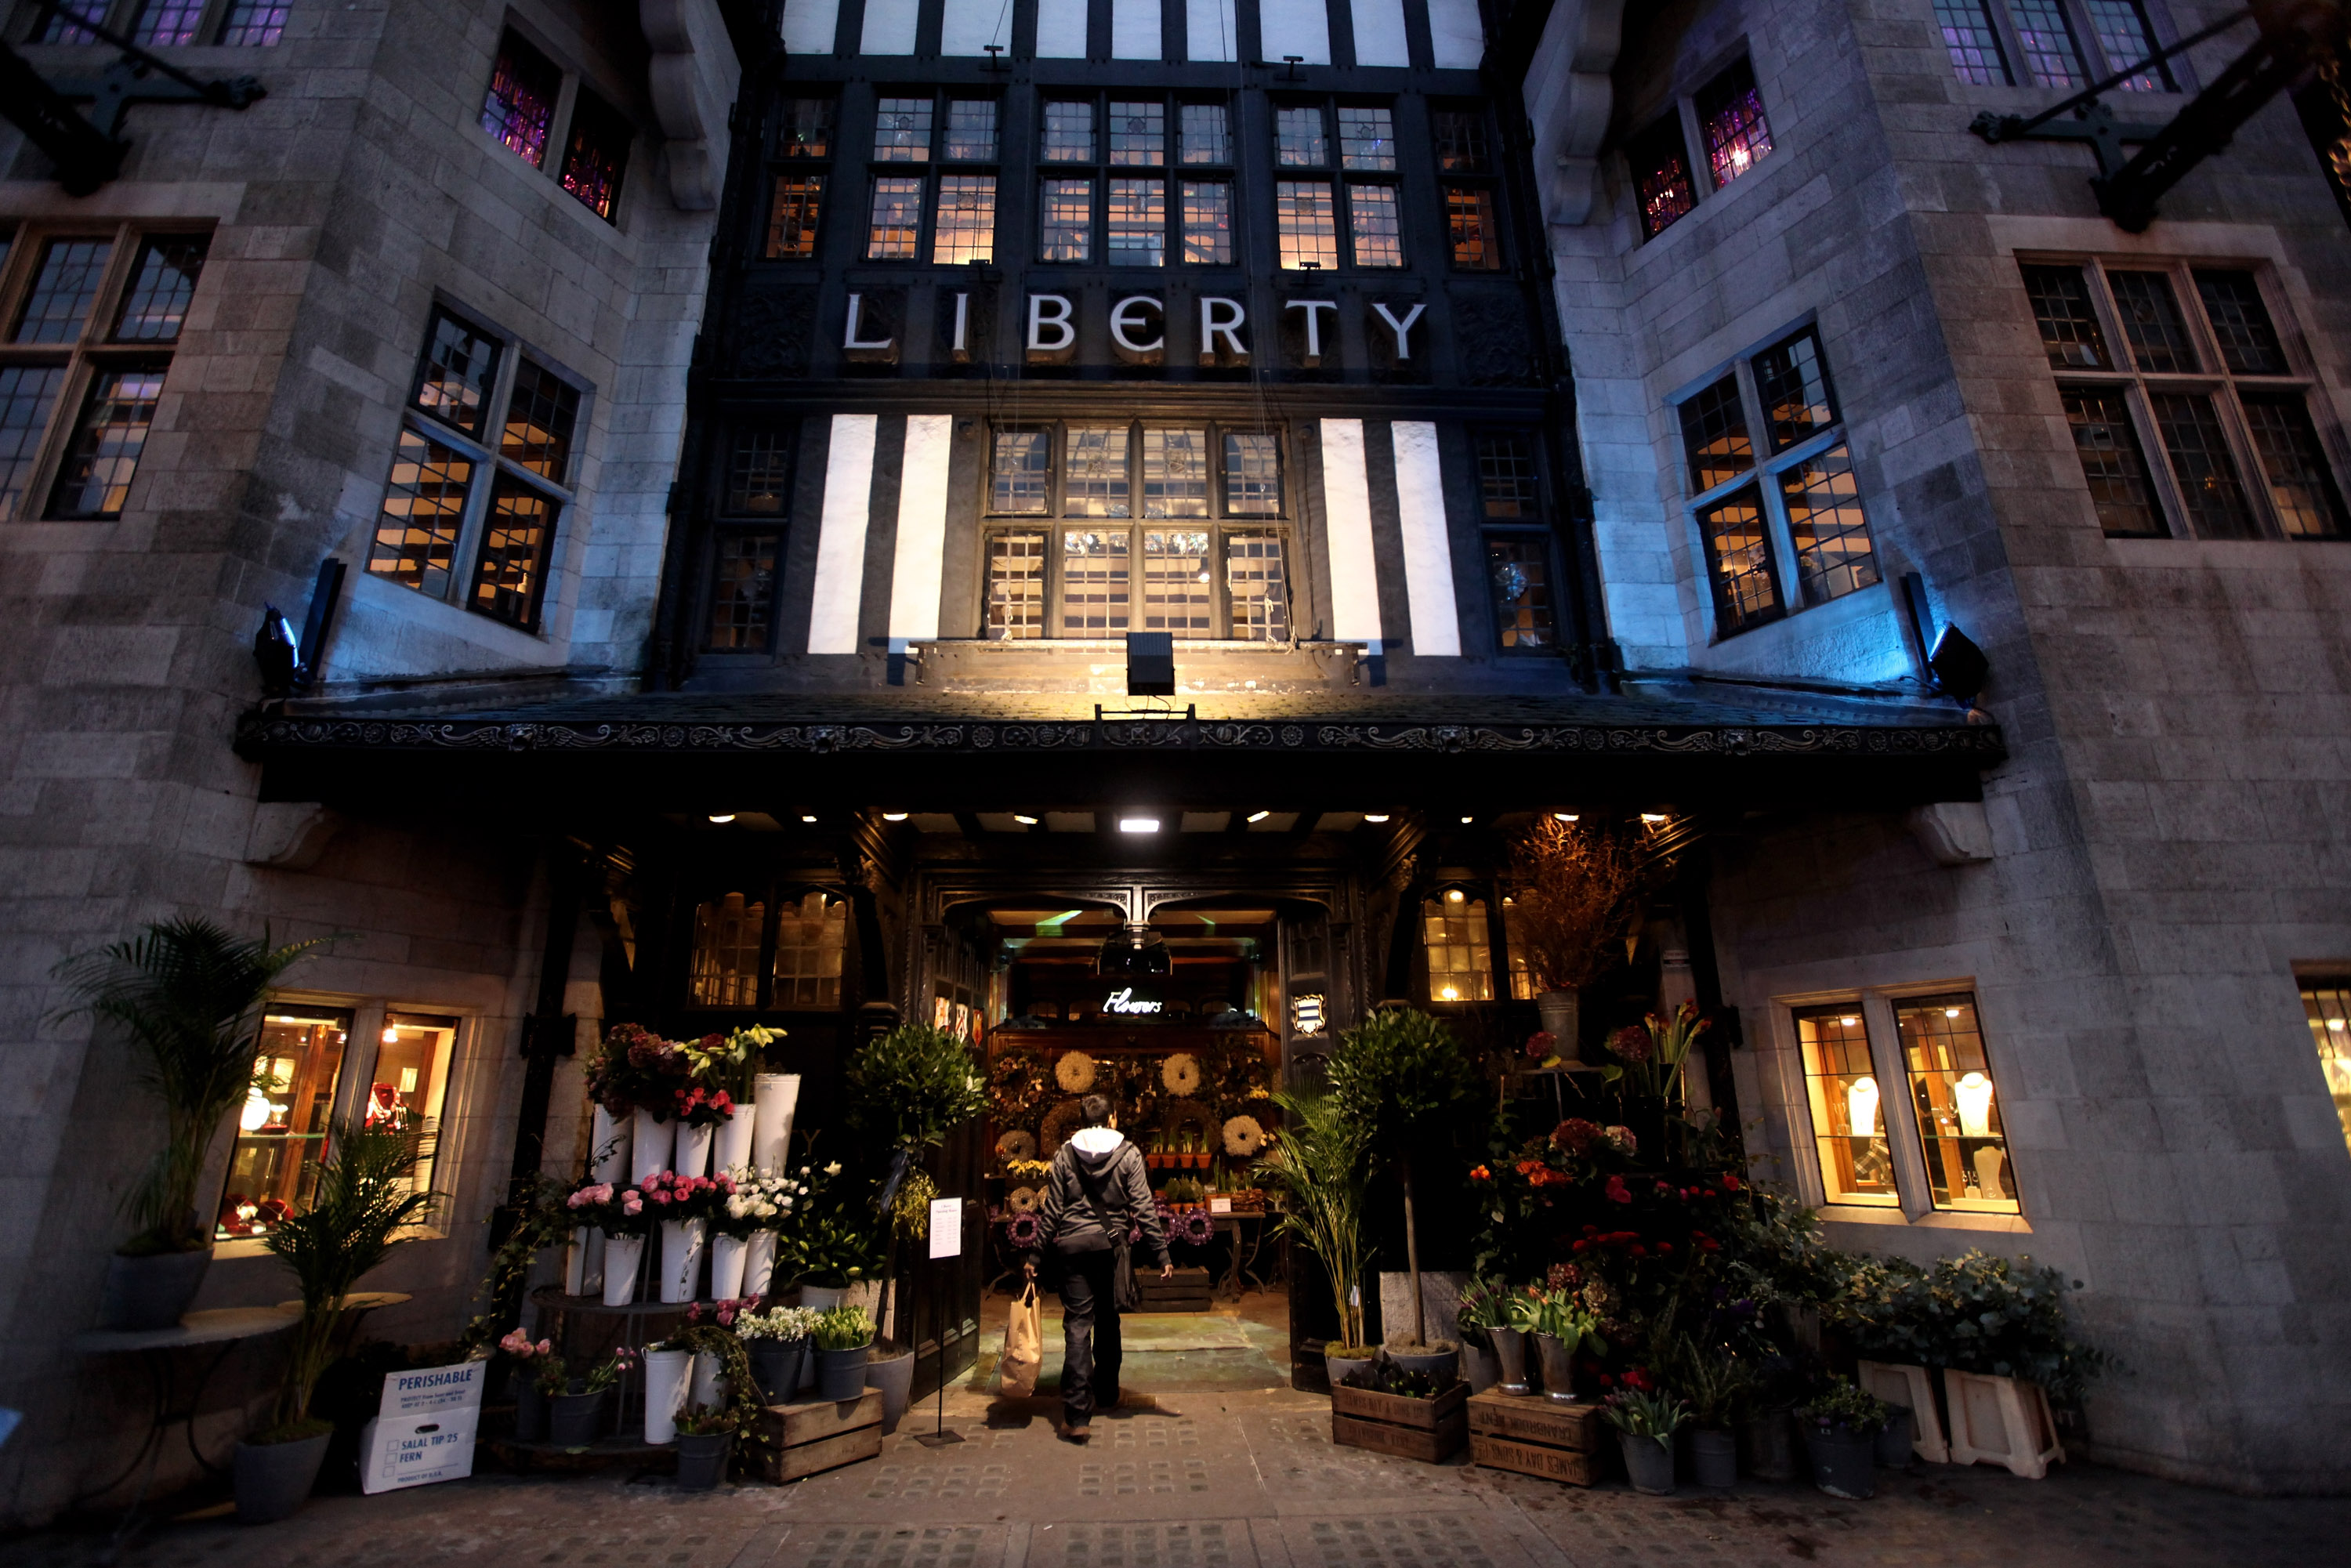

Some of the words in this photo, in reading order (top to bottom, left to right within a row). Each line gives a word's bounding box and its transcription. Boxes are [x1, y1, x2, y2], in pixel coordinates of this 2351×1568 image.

[843, 292, 1428, 360] LIBERTY
[1103, 987, 1162, 1014] Flowers
[398, 1369, 473, 1390] PERISHABLE
[400, 1437, 427, 1450] SALAL
[431, 1435, 444, 1447] TIP
[447, 1432, 458, 1443] 25
[399, 1451, 423, 1464] FERN
[1525, 1450, 1543, 1471] DAY
[1547, 1455, 1577, 1477] JAMES
